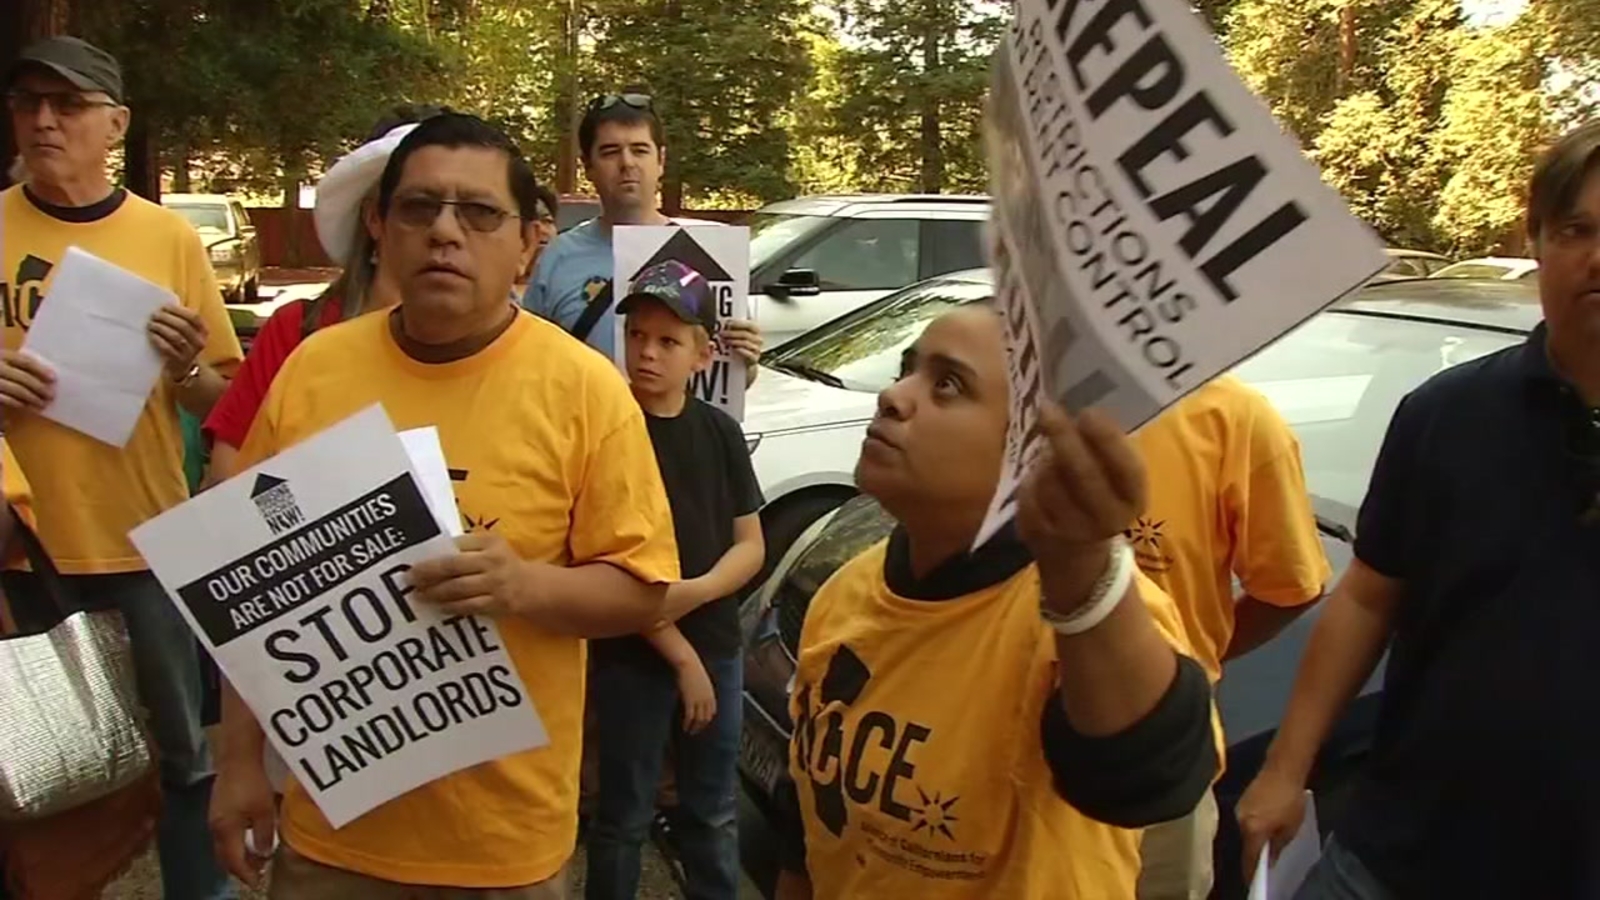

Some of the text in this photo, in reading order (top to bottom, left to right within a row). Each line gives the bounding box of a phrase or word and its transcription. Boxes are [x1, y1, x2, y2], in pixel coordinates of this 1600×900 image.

[1055, 190, 1194, 391] CONTROL
[208, 565, 259, 601] OUR
[254, 493, 397, 578] COMMUNITIES
[228, 526, 406, 630] ARE NOT FOR SALE:
[264, 563, 419, 684] STOP
[269, 613, 499, 748] CORPORATE
[299, 664, 522, 792] LANDLORDS
